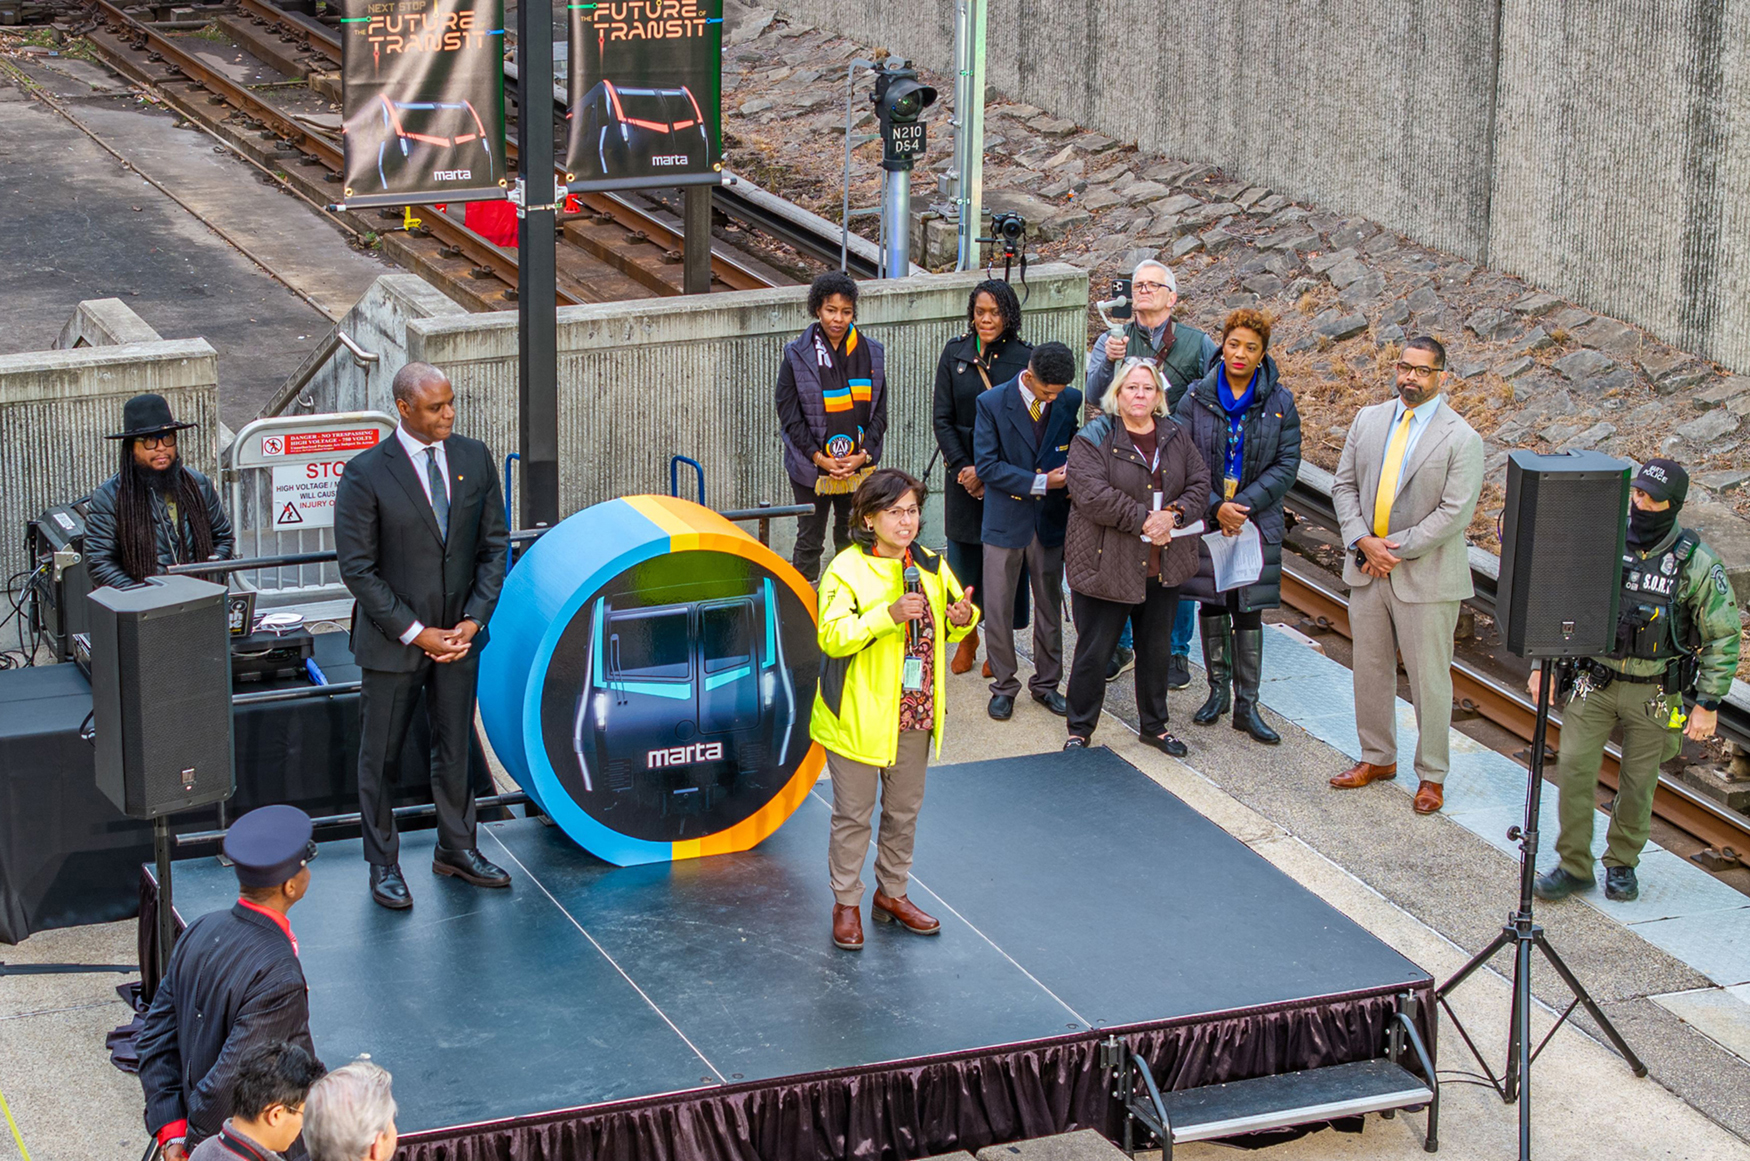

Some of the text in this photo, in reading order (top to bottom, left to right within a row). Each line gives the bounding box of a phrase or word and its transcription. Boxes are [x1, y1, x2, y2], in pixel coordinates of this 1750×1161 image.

[367, 1, 426, 13] NEXT STOP
[593, 0, 697, 21] FUTURE
[368, 11, 475, 34] FUTURE
[593, 19, 706, 41] TRANSIT
[368, 31, 485, 54] TRANSIT
[893, 126, 922, 140] N210
[652, 154, 688, 166] marta
[433, 169, 471, 181] marta
[306, 461, 346, 479] STO
[1642, 469, 1668, 484] POLICE
[276, 484, 294, 492] HIGH
[295, 481, 328, 491] VOLTAGE
[300, 490, 336, 500] WILL CAUS
[300, 499, 336, 509] INJURY O
[647, 742, 722, 768] marta
